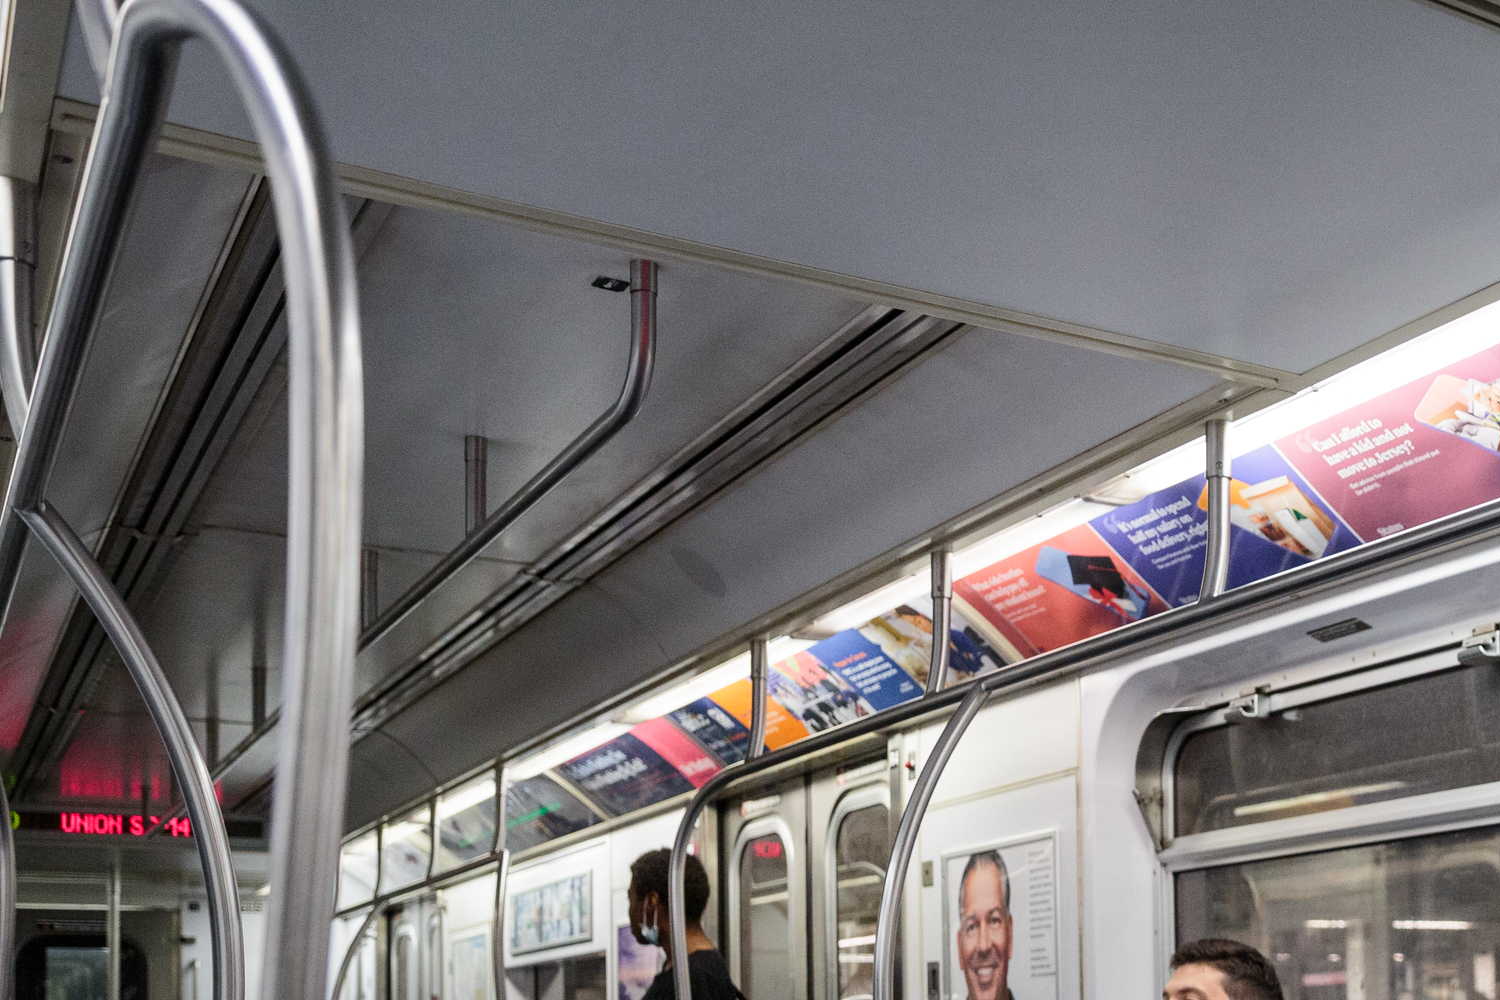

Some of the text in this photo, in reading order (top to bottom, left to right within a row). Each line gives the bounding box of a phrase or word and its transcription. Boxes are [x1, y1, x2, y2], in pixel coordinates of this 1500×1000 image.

[1312, 418, 1382, 452] Can I afford to
[1322, 422, 1414, 466] have a kid and not
[1337, 439, 1415, 479] move to Jersey?
[61, 812, 123, 835] UNION
